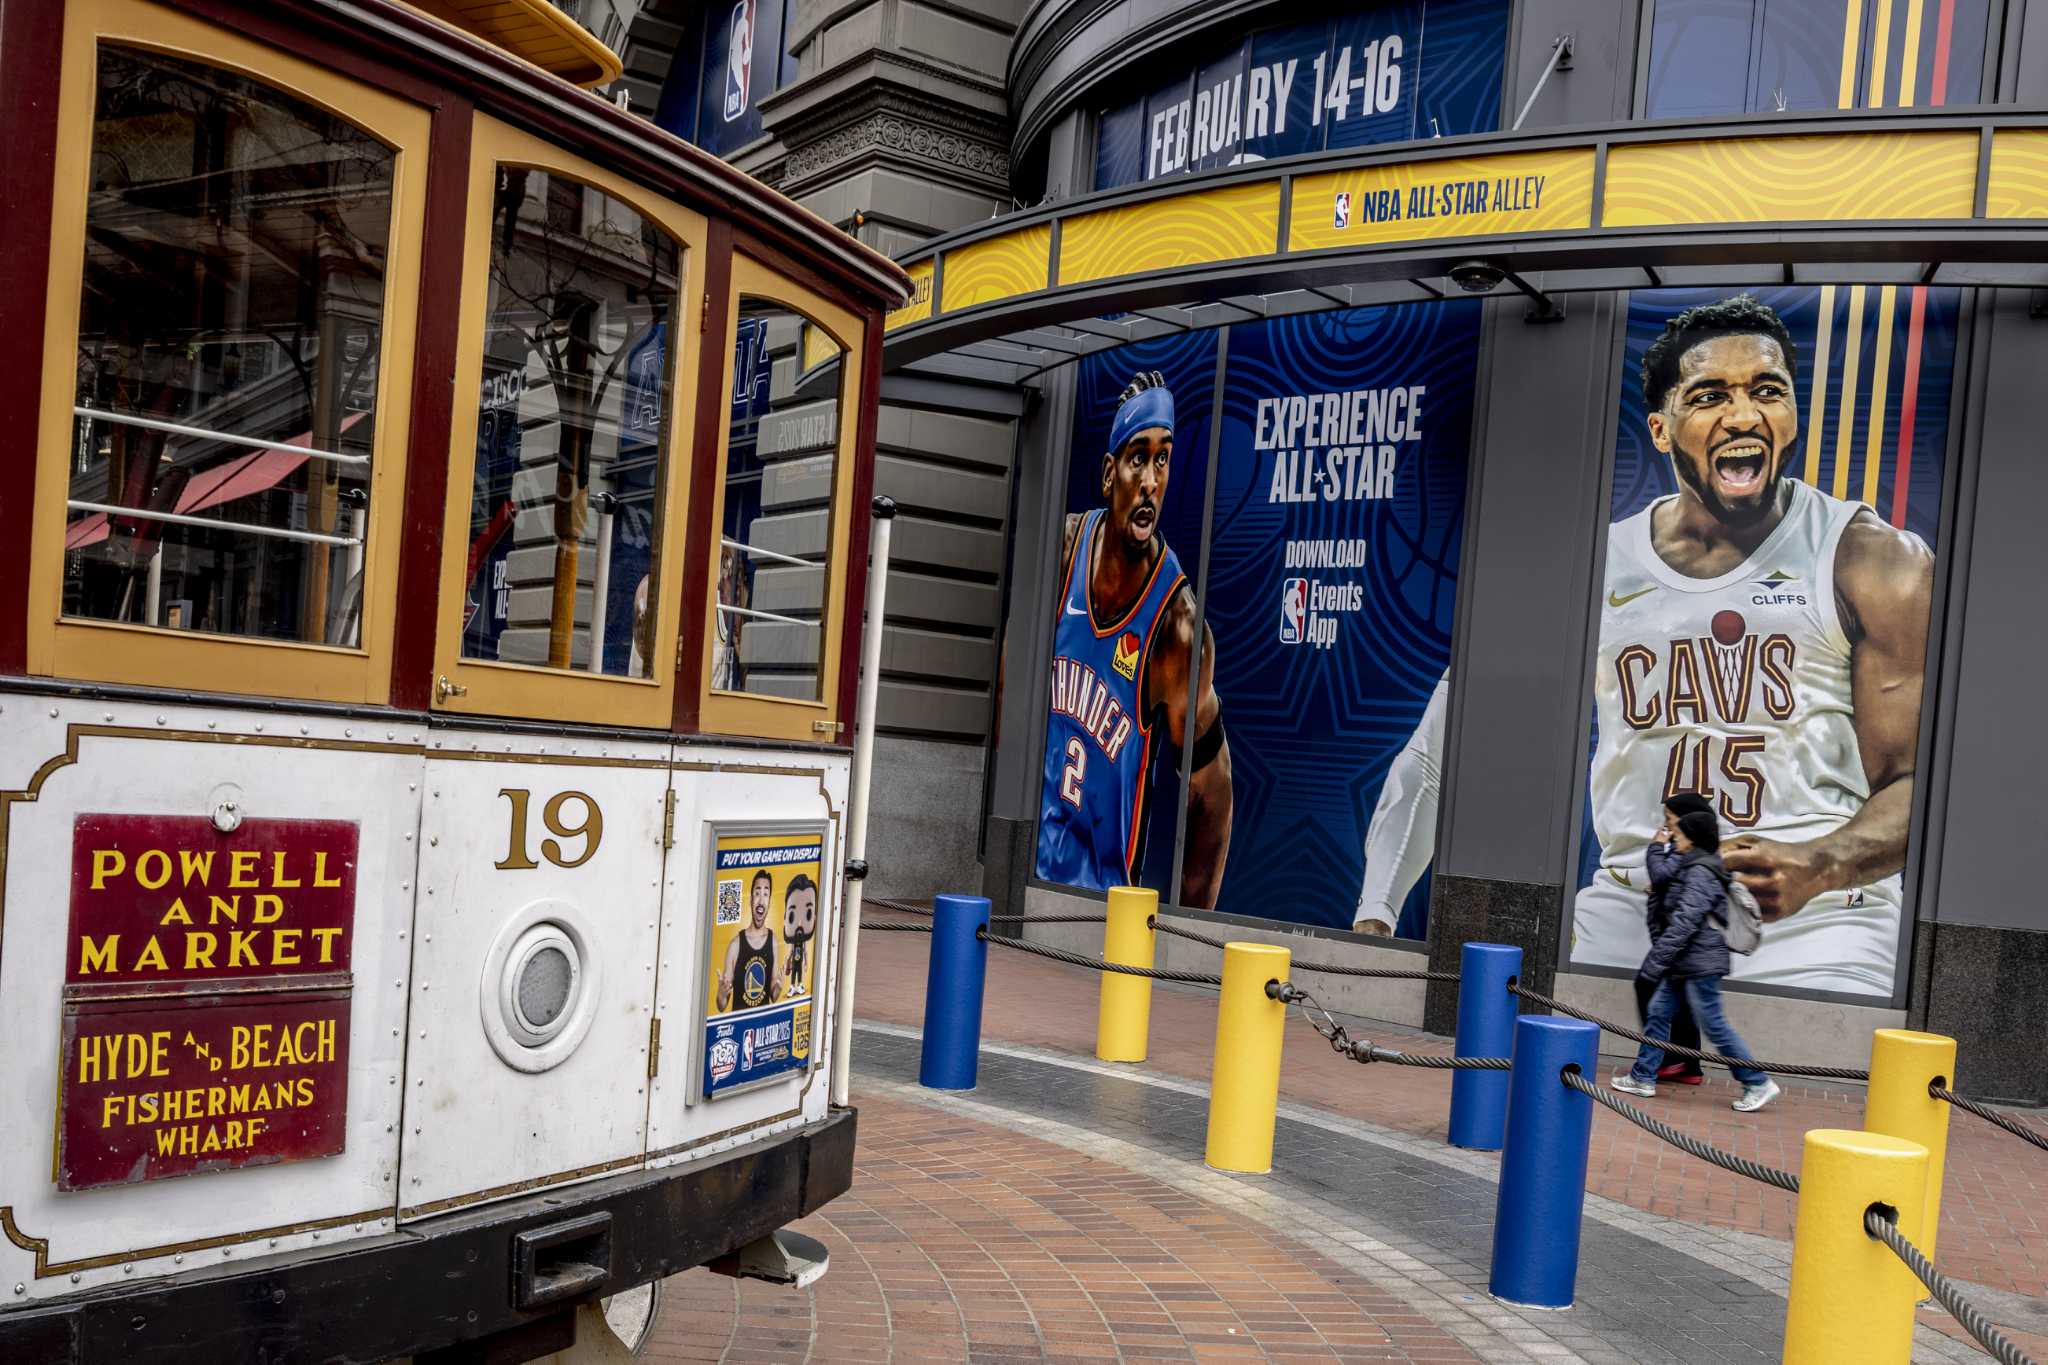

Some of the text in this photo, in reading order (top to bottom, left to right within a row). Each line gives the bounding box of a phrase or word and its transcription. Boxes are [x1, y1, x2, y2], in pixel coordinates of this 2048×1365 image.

[1148, 34, 1403, 181] FEBRUARY 14-16
[1363, 189, 1401, 224] NBA
[1492, 175, 1545, 212] ALLEY
[1254, 385, 1426, 450] EXPERIENCE
[1285, 539, 1366, 568] DOWNLOAD
[1310, 579, 1363, 611] Events
[1752, 594, 1807, 606] CLIFFS
[1306, 611, 1338, 649] App
[1615, 634, 1796, 730] CAVS
[1061, 736, 1087, 811] 2
[1662, 733, 1766, 828] 45
[494, 788, 603, 870] 19
[90, 849, 342, 889] POWELL
[721, 853, 741, 866] PUT
[739, 851, 761, 865] YOUR
[761, 850, 783, 863] GAME
[781, 849, 795, 861] ON
[160, 895, 285, 926] AND
[78, 927, 343, 975] MARKET
[78, 1019, 336, 1084] HYDE AND BEACH
[101, 1078, 315, 1128] FISHERMANS
[155, 1118, 266, 1157] WHARF
